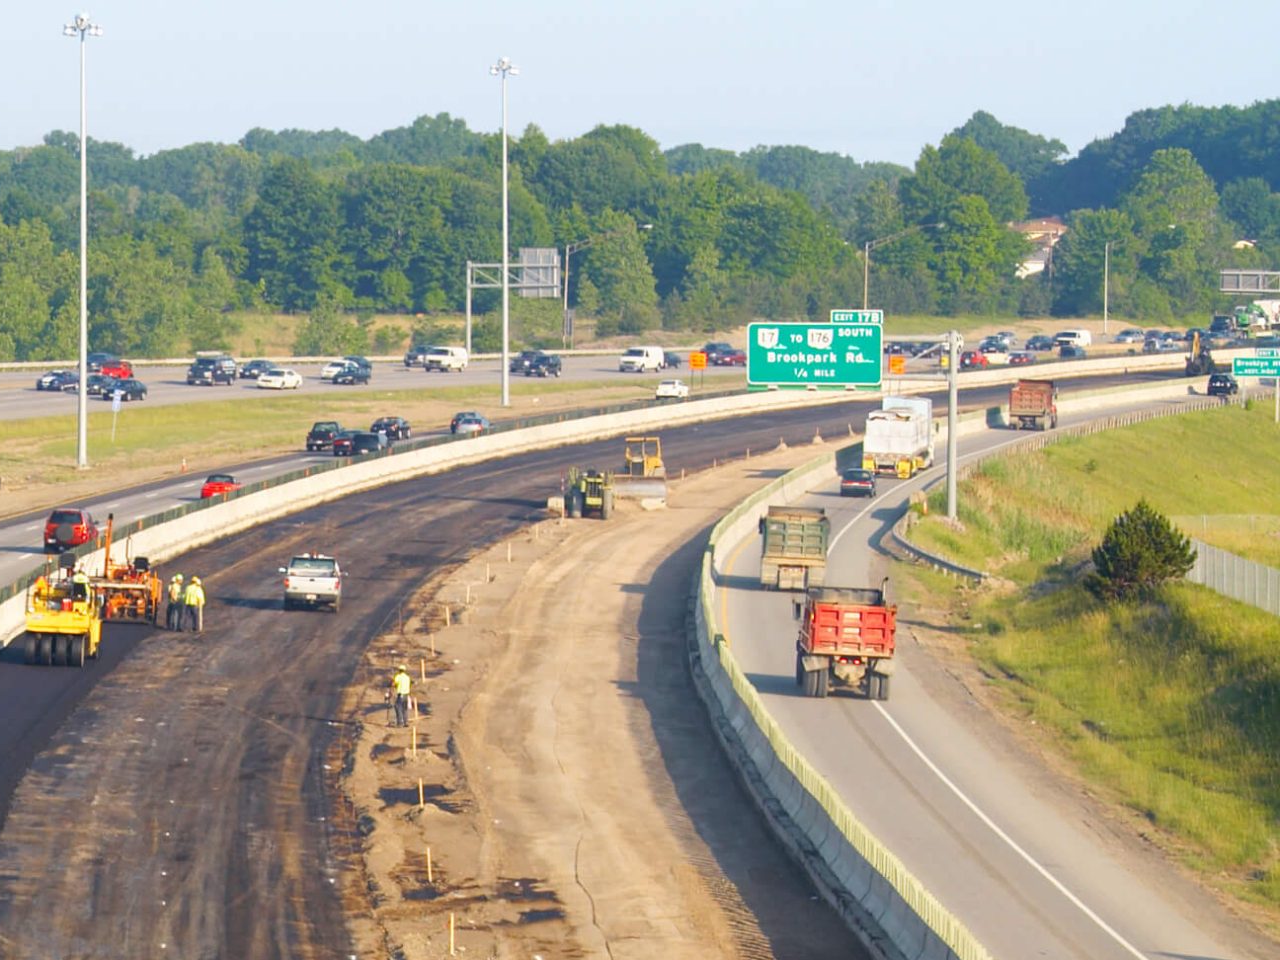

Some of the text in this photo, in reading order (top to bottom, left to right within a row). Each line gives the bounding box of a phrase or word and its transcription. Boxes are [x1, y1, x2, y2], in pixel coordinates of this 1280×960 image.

[834, 312, 880, 323] EXIT 17B
[762, 332, 829, 343] 17 TO 176
[838, 328, 873, 337] SOUTH
[767, 351, 837, 365] Brookpark
[814, 369, 835, 377] MILE
